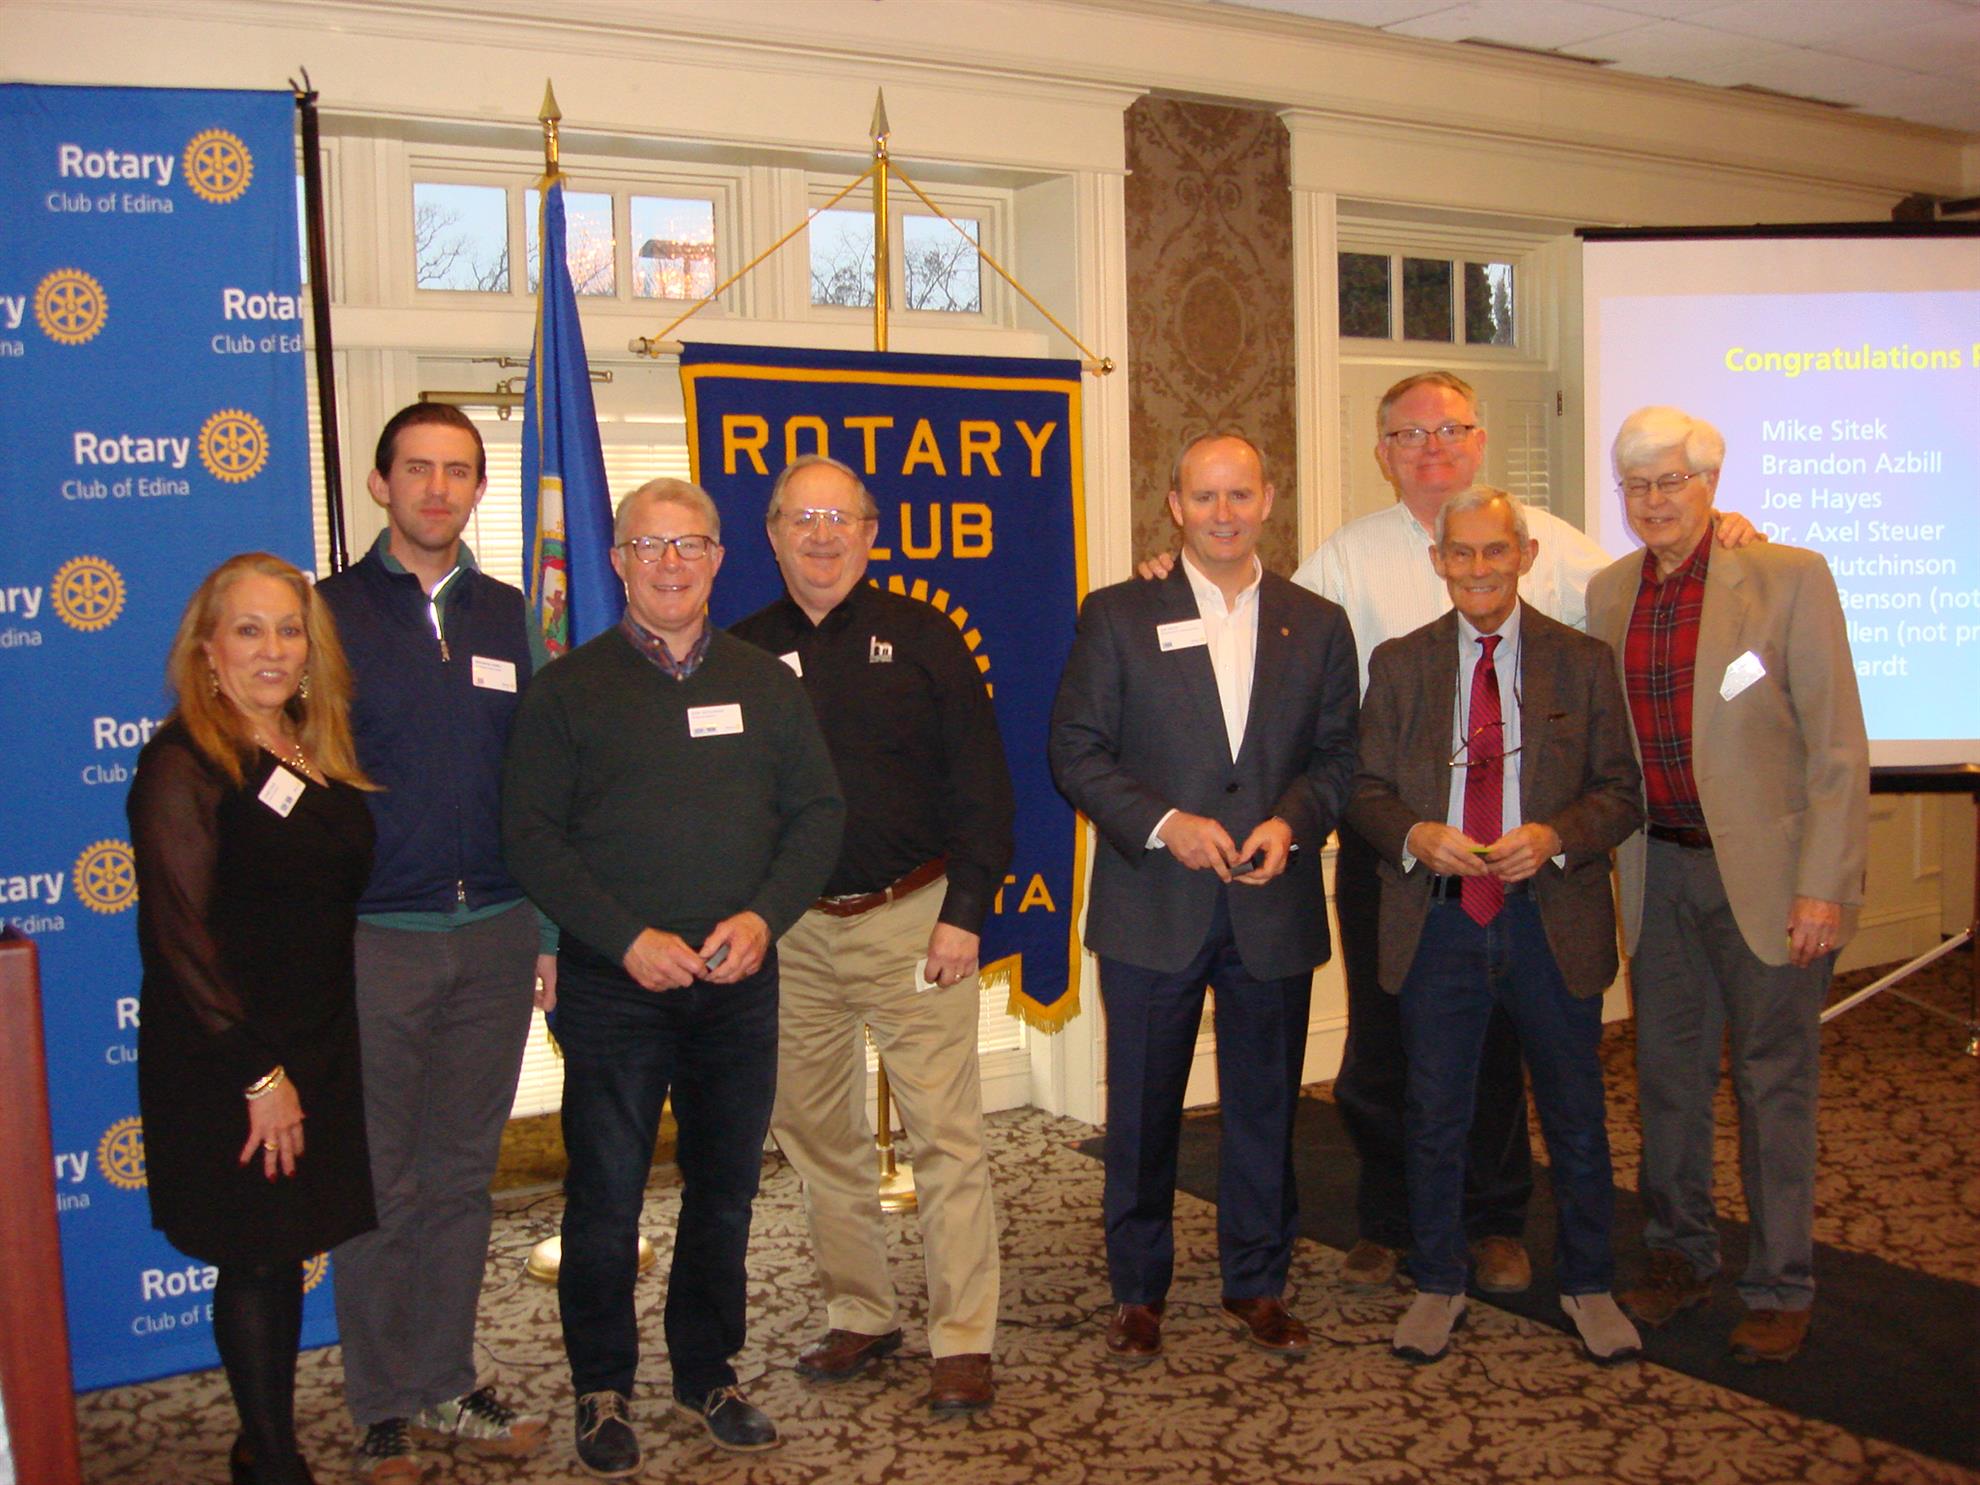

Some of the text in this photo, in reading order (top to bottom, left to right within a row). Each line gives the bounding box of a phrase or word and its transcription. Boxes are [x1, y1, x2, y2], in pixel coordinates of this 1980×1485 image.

[60, 144, 175, 187] Rotary
[47, 192, 174, 214] Club of Edina
[211, 334, 256, 354] Club
[260, 334, 277, 353] of
[1725, 341, 1963, 378] Congratulations
[1762, 416, 1888, 442] Mike Sitek
[74, 431, 191, 469] Rotary
[721, 414, 1058, 477] ROTARY
[1762, 449, 1942, 475] Brandon Azbill
[61, 476, 190, 501] Club of Edina
[1761, 487, 1882, 515] Joe Hayes
[1762, 518, 1945, 543] Dr. Axel Steuer
[1929, 584, 1980, 615] (not
[1897, 619, 1947, 647] (not
[82, 763, 128, 785] Club
[132, 1311, 176, 1335] Club
[180, 1304, 199, 1327] of
